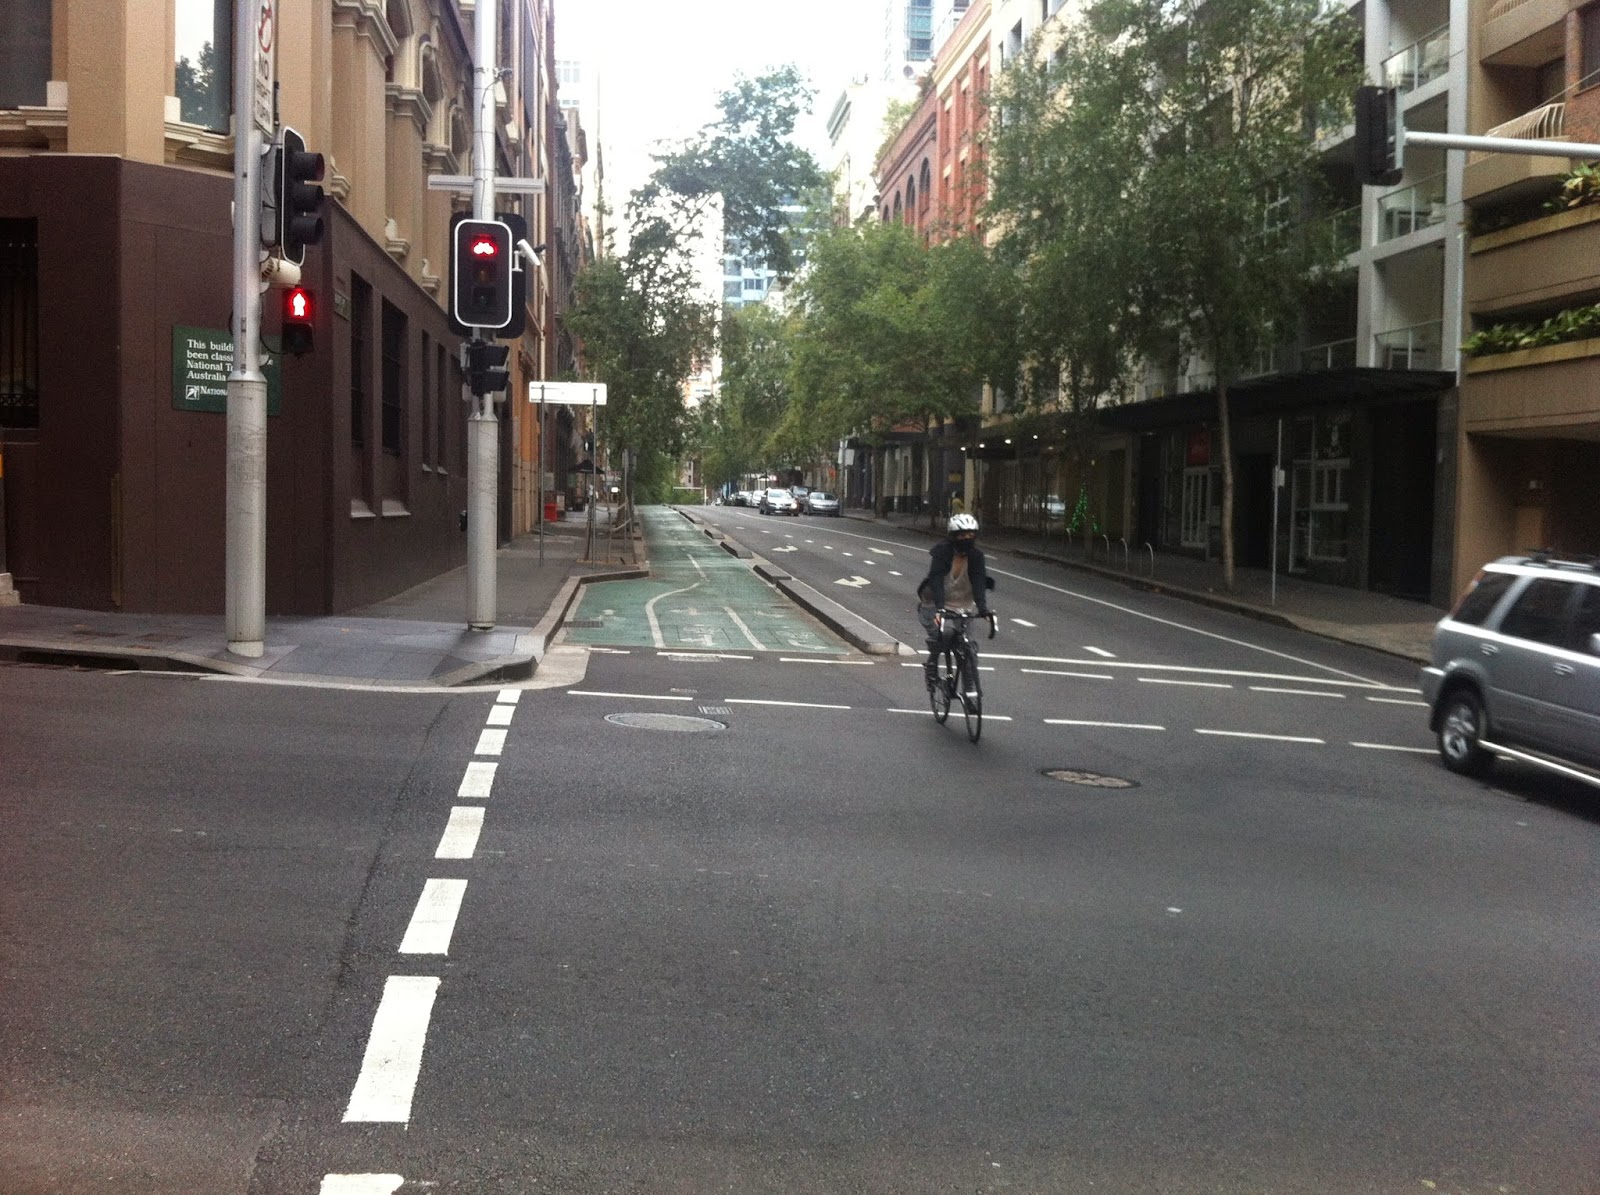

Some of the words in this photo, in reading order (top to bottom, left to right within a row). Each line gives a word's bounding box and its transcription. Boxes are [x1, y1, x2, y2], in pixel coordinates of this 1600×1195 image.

[187, 339, 206, 349] This
[210, 341, 233, 352] buildi
[187, 350, 208, 360] been
[211, 352, 233, 362] classi
[187, 360, 222, 371] National
[187, 371, 226, 381] Australia
[200, 386, 227, 396] NATION
